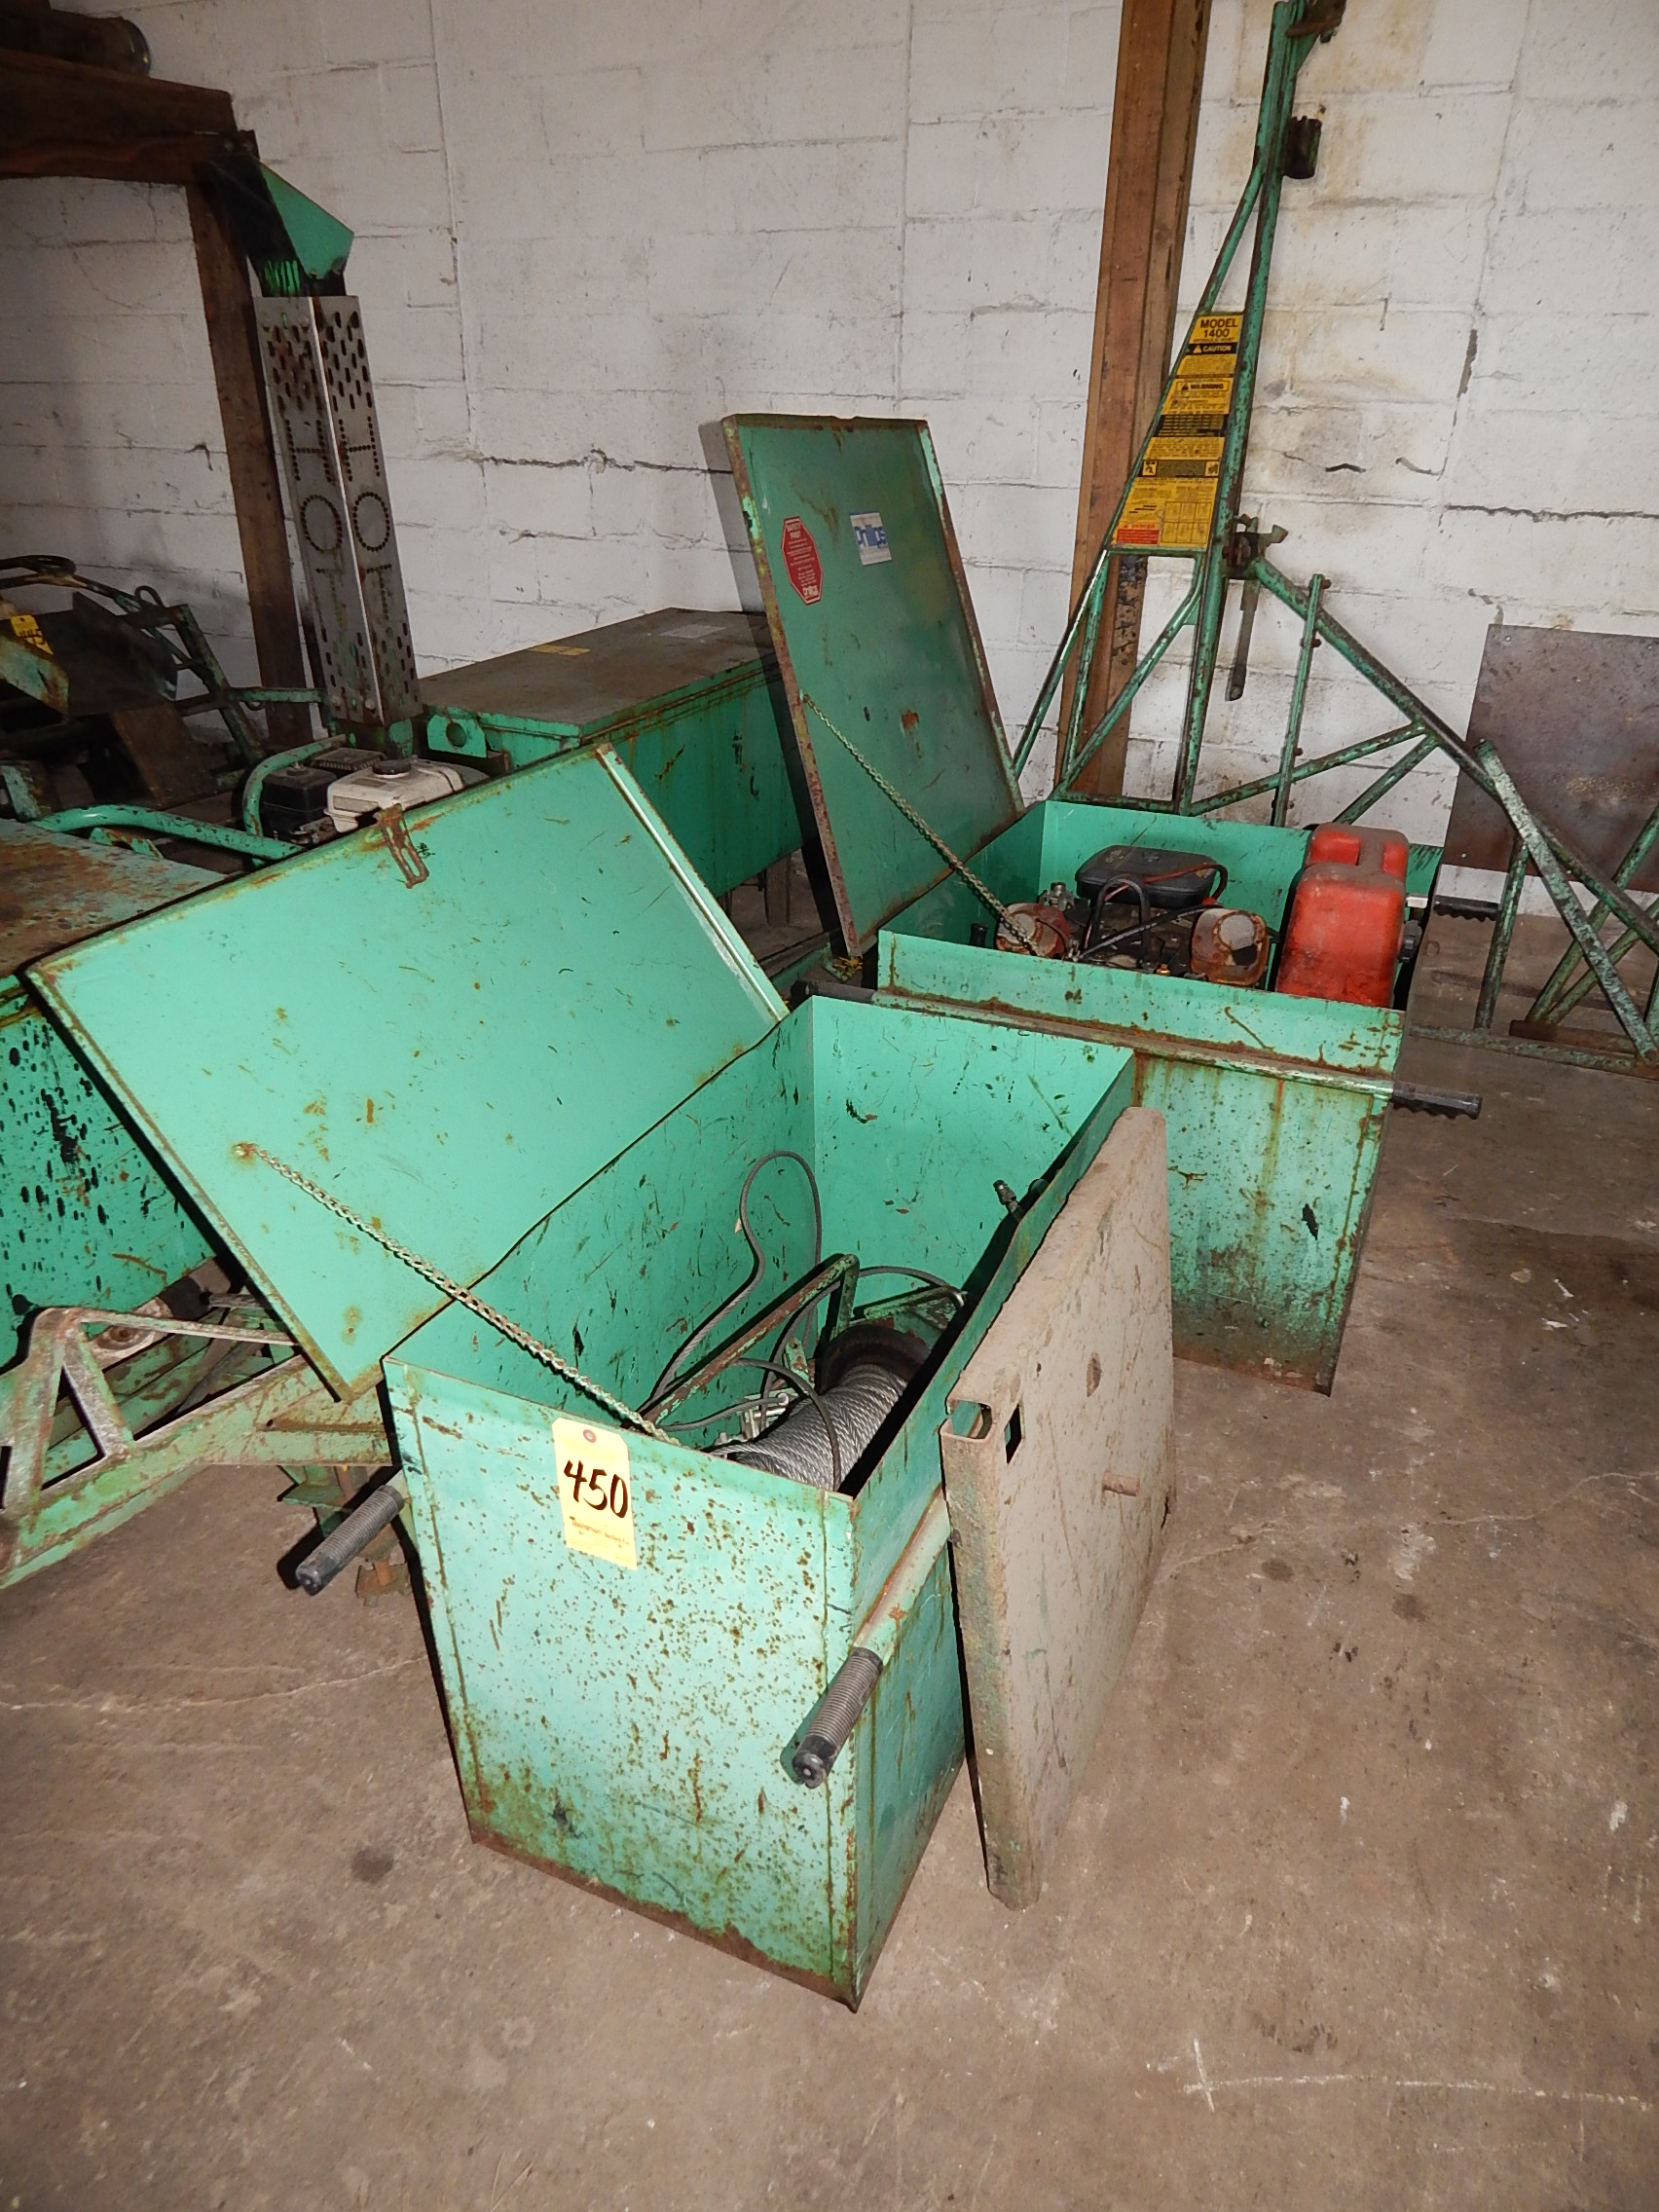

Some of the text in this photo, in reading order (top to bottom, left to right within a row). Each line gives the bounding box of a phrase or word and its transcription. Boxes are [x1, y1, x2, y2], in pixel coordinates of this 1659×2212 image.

[1199, 318, 1237, 328] MODEL
[1203, 328, 1230, 338] 1400
[339, 416, 392, 619] HOT
[564, 1459, 628, 1519] 450
